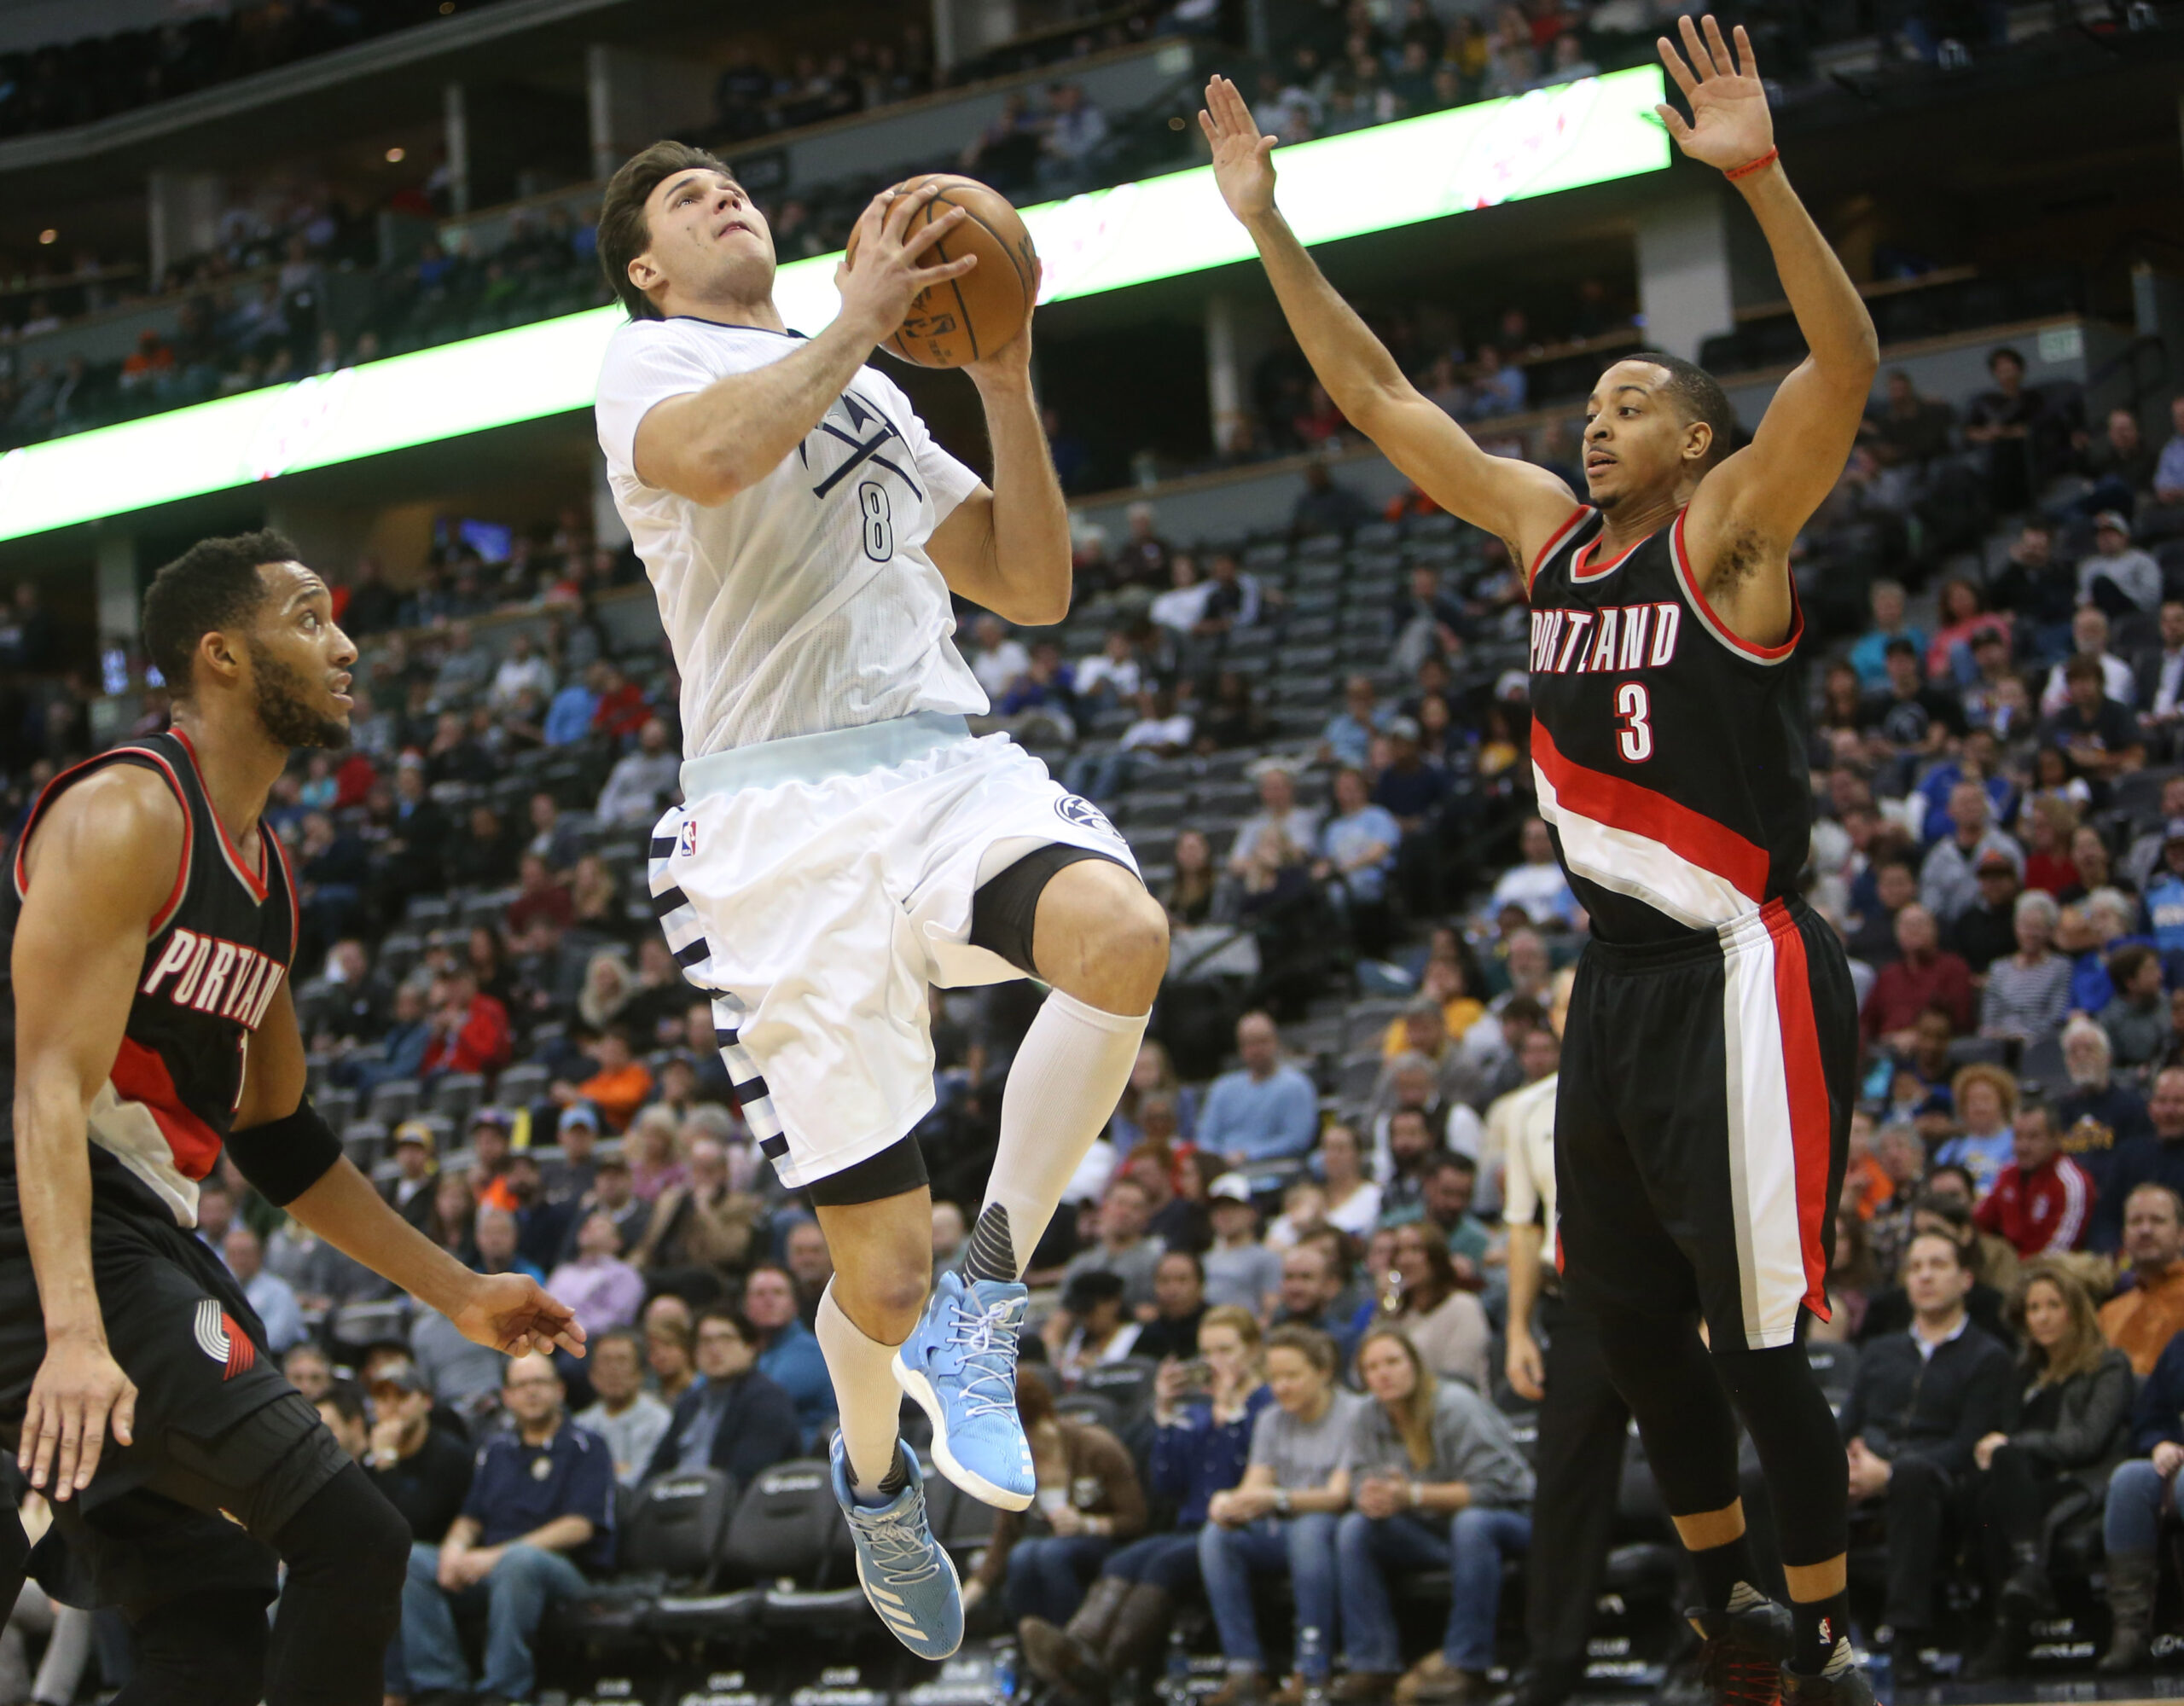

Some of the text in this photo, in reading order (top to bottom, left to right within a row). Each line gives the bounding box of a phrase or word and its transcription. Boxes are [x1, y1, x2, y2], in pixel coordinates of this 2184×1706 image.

[858, 480, 893, 563] 8
[1529, 601, 1682, 674] PORTLAND
[1614, 681, 1654, 763] 3
